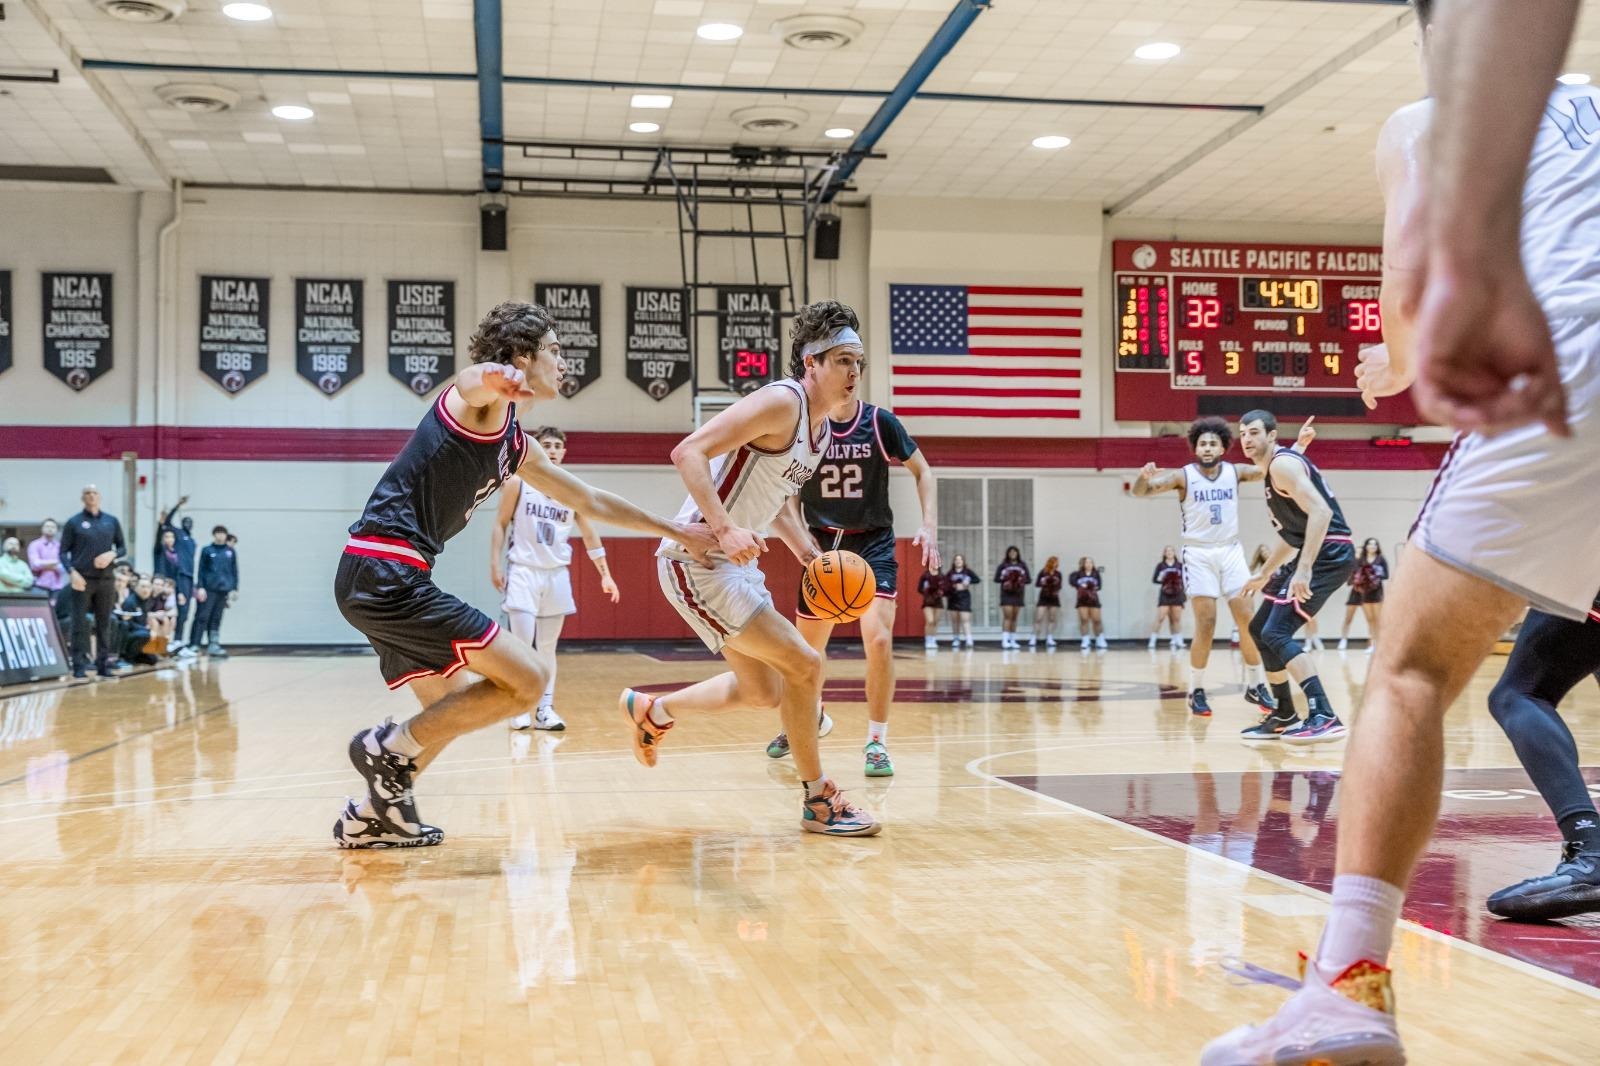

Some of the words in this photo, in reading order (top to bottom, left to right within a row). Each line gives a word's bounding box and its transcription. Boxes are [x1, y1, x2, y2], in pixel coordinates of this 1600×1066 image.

[1170, 248, 1240, 268] SEATTLE
[1246, 250, 1311, 270] PACIFIC
[52, 277, 102, 298] NCAA
[211, 280, 259, 302] NCAA
[306, 283, 353, 304] NCAA
[399, 285, 443, 305] USGF
[1182, 282, 1218, 296] HOME
[1259, 280, 1319, 310] 4:40
[545, 288, 591, 308] NCAA
[636, 292, 681, 312] USAG
[727, 293, 772, 312] NCAA
[51, 310, 103, 323] NATIONAL
[396, 305, 445, 315] COLLEGIATE
[634, 311, 682, 321] COLLEGIATE
[1186, 299, 1220, 328] 32
[1348, 302, 1381, 331] 36
[208, 313, 260, 327] NATIONAL
[303, 316, 354, 329] NATIONAL
[396, 317, 446, 331] NATIONAL
[1254, 319, 1288, 331] PERIOD
[1296, 315, 1305, 335] 1
[45, 323, 110, 338] CHAMPIONS
[202, 326, 266, 342] CHAMPIONS
[299, 328, 360, 343] CHAMPIONS
[391, 330, 451, 344] CHAMPIONS
[634, 323, 683, 337] NATIONAL
[629, 336, 688, 350] CHAMPIONS
[1252, 341, 1287, 353] PLAYER
[1288, 341, 1312, 353] FOUL
[60, 349, 96, 368] 1985
[216, 352, 252, 371] 1986
[312, 354, 347, 372] 1986
[405, 356, 439, 373] 1992
[735, 351, 768, 377] 24
[1187, 352, 1201, 374] 5
[1225, 351, 1240, 375] 3
[1324, 354, 1340, 375] 4
[642, 361, 675, 378] 1997
[826, 443, 872, 460] OLVES
[820, 464, 863, 498] 22
[1194, 487, 1233, 502] FALCONS
[526, 502, 569, 523] FALCONS
[1209, 503, 1222, 525] 3
[536, 521, 556, 546] 10
